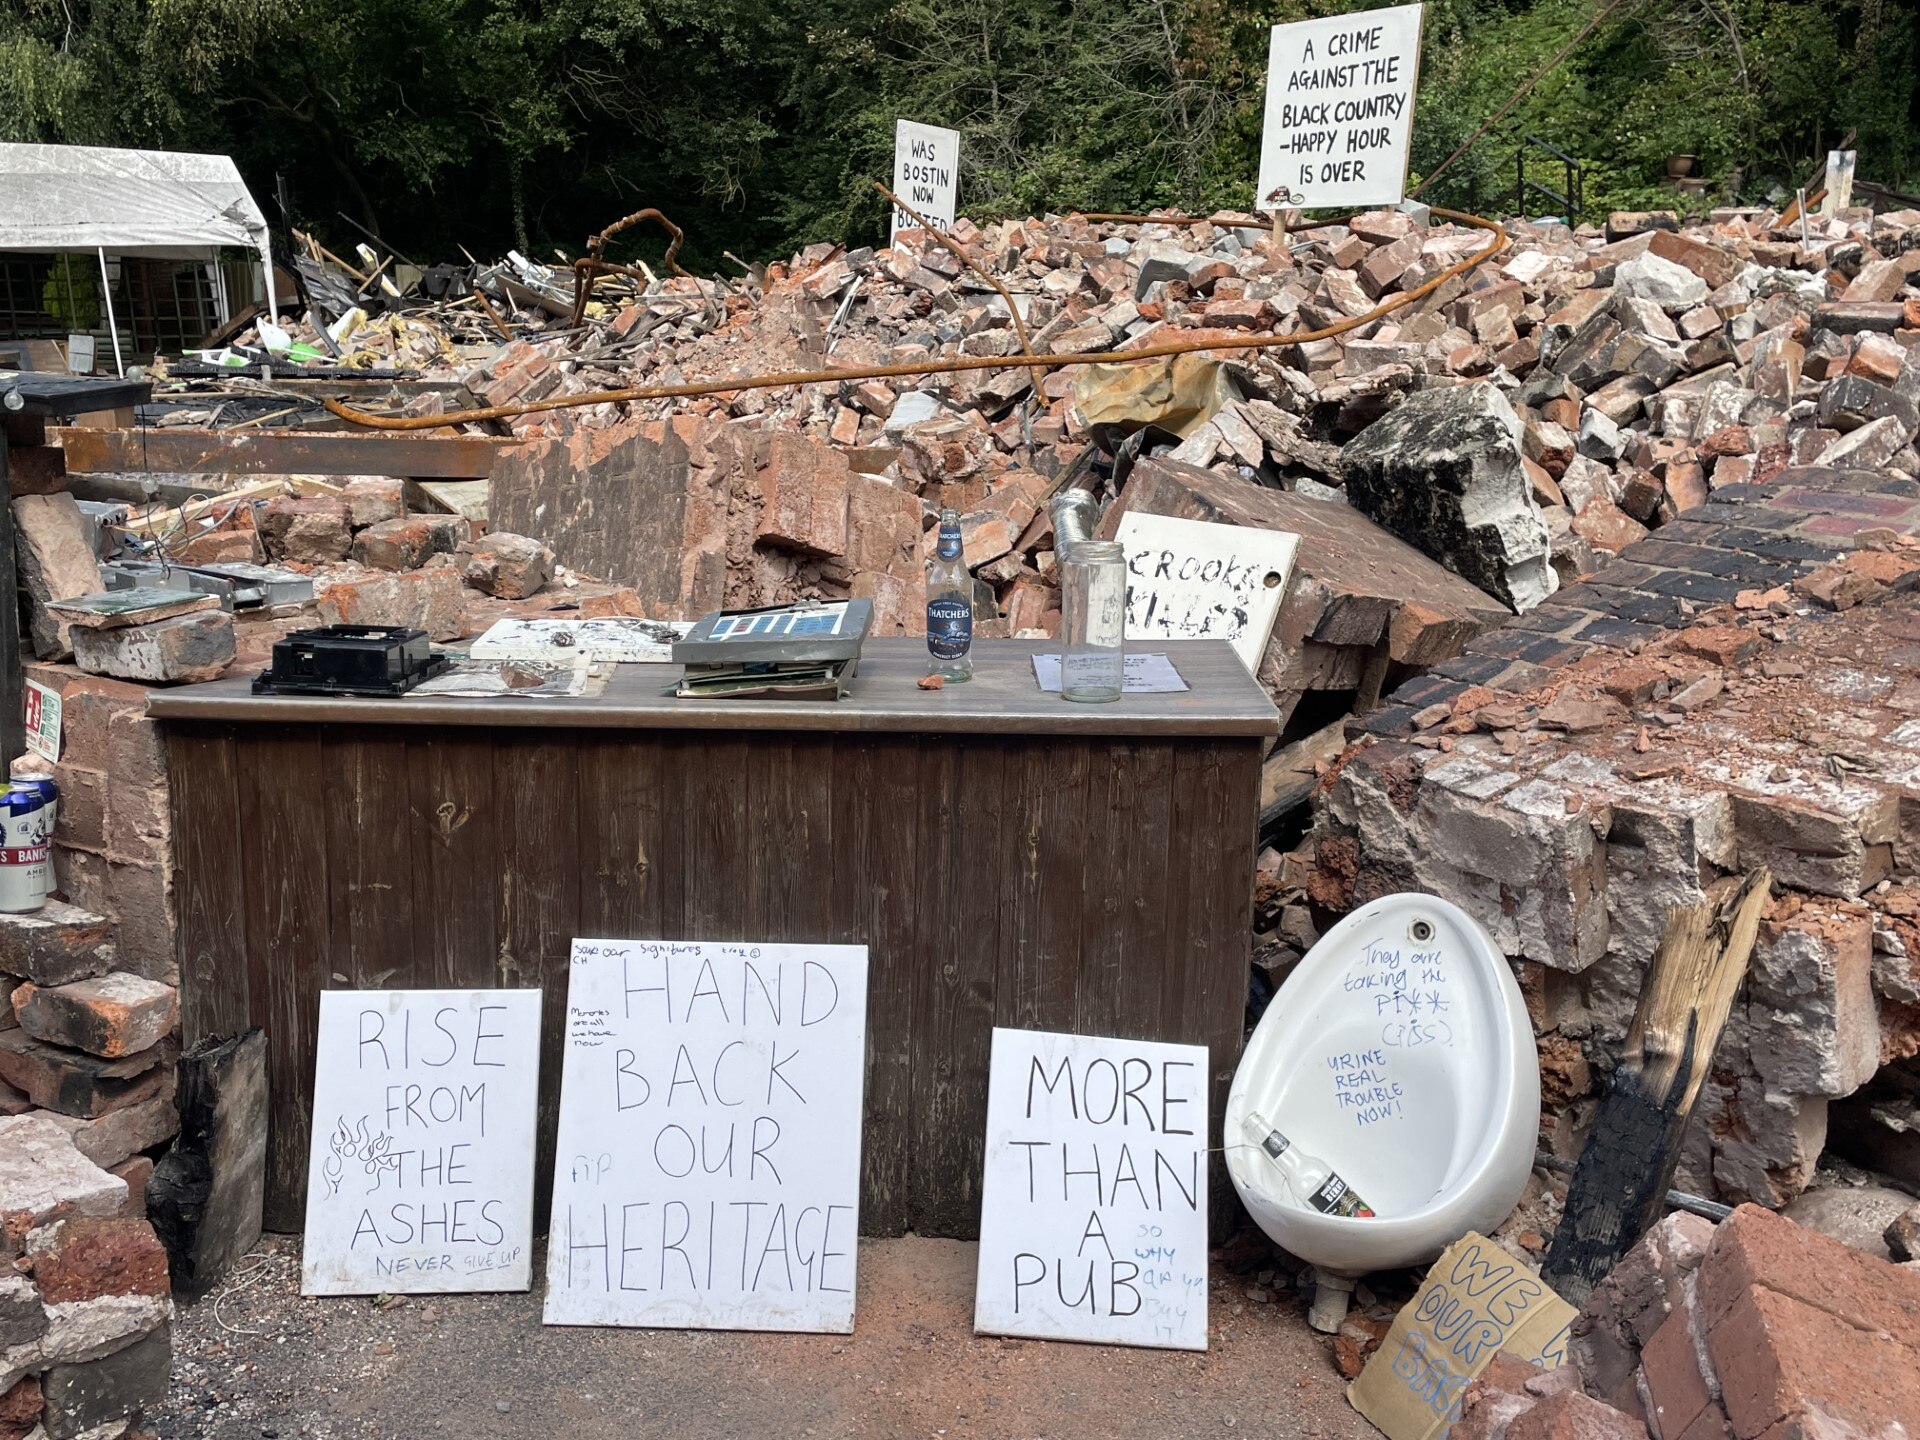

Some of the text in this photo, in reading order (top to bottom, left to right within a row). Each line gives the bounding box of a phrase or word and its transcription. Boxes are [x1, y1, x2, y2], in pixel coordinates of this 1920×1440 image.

[1302, 26, 1383, 63] A CRIME
[1287, 56, 1400, 92] AGAINST THE
[1282, 92, 1407, 129] BLACK COUNTRY
[911, 139, 935, 161] WAS
[1347, 127, 1391, 153] HOUR
[903, 162, 949, 187] BOSTIN
[1299, 160, 1366, 185] IS OVER
[912, 185, 934, 204] NOW
[928, 606, 969, 619] THATCHERS
[624, 957, 838, 1027] HAND
[1344, 968, 1446, 991] taking the
[359, 1005, 508, 1070] RISE
[615, 1040, 807, 1112] BACK
[1327, 1049, 1386, 1071] URINE
[1335, 1069, 1386, 1090] REAL
[385, 1082, 485, 1138] FROM
[1026, 1055, 1195, 1136] MORE
[1335, 1082, 1403, 1108] TROUBLE
[382, 1143, 472, 1189] THE
[654, 1116, 782, 1185] OUR
[1009, 1141, 1198, 1212] THAN
[350, 1200, 504, 1250] ASHES
[1077, 1210, 1115, 1261] A
[375, 1255, 455, 1276] NEVER
[463, 1251, 493, 1268] GIVE
[567, 1201, 854, 1293] HERITAGE
[1014, 1252, 1142, 1317] PUB
[1450, 1245, 1542, 1326] WE
[1414, 1283, 1503, 1364] OUR
